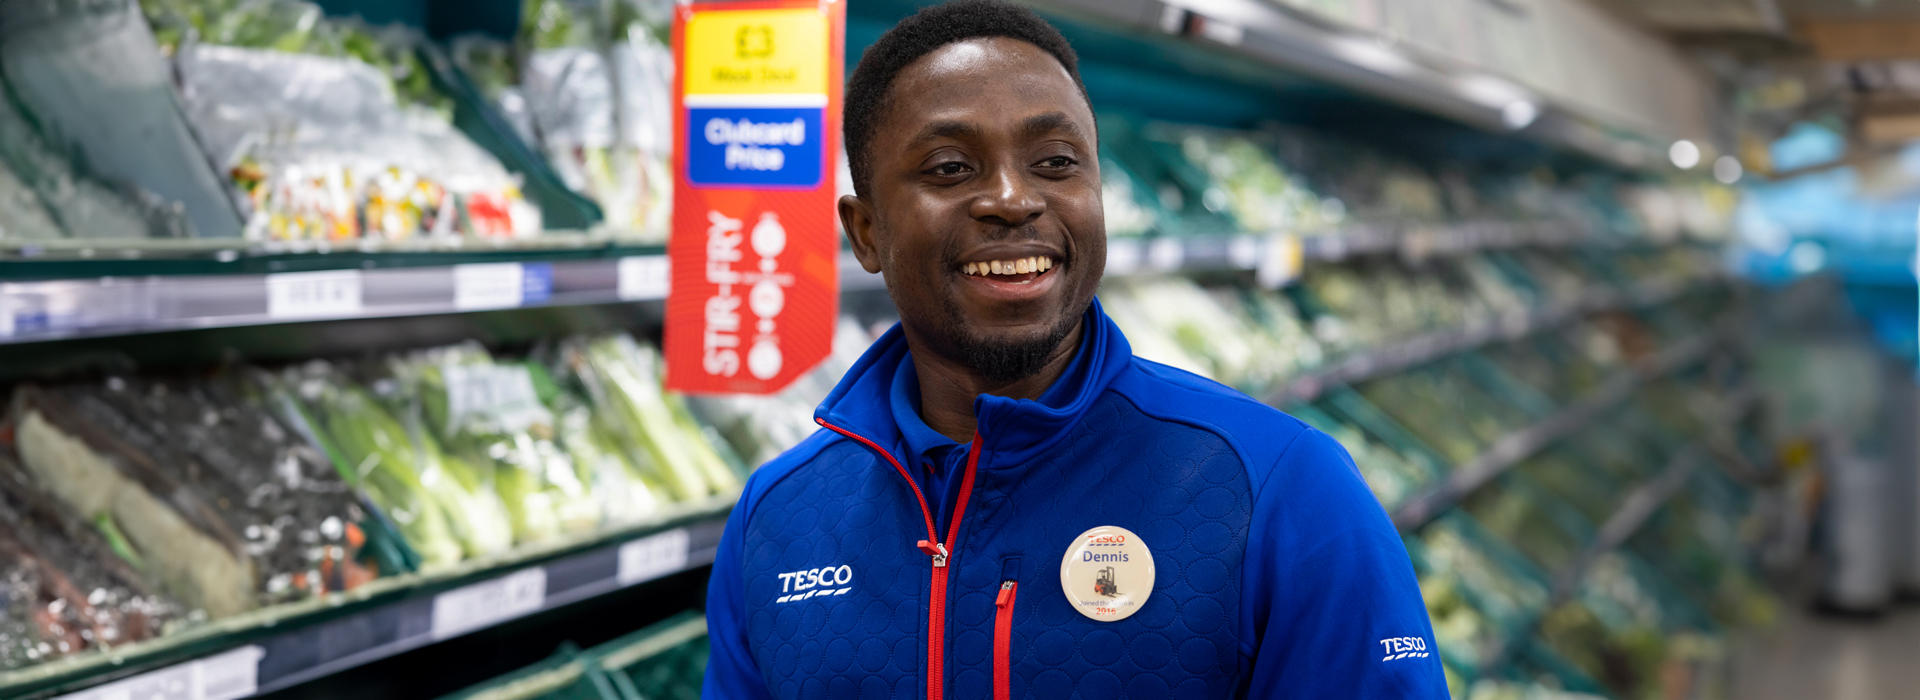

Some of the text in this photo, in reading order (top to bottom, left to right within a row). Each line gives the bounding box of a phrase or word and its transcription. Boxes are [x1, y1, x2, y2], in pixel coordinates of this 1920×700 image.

[704, 117, 806, 146] Clubcard
[725, 144, 785, 171] Price
[703, 210, 743, 377] STIR-FRY
[1088, 535, 1125, 543] TESCO
[1083, 551, 1129, 562] Dennis
[778, 564, 852, 592] TESCO
[1096, 607, 1116, 615] 2016
[1380, 636, 1426, 654] TESCO
